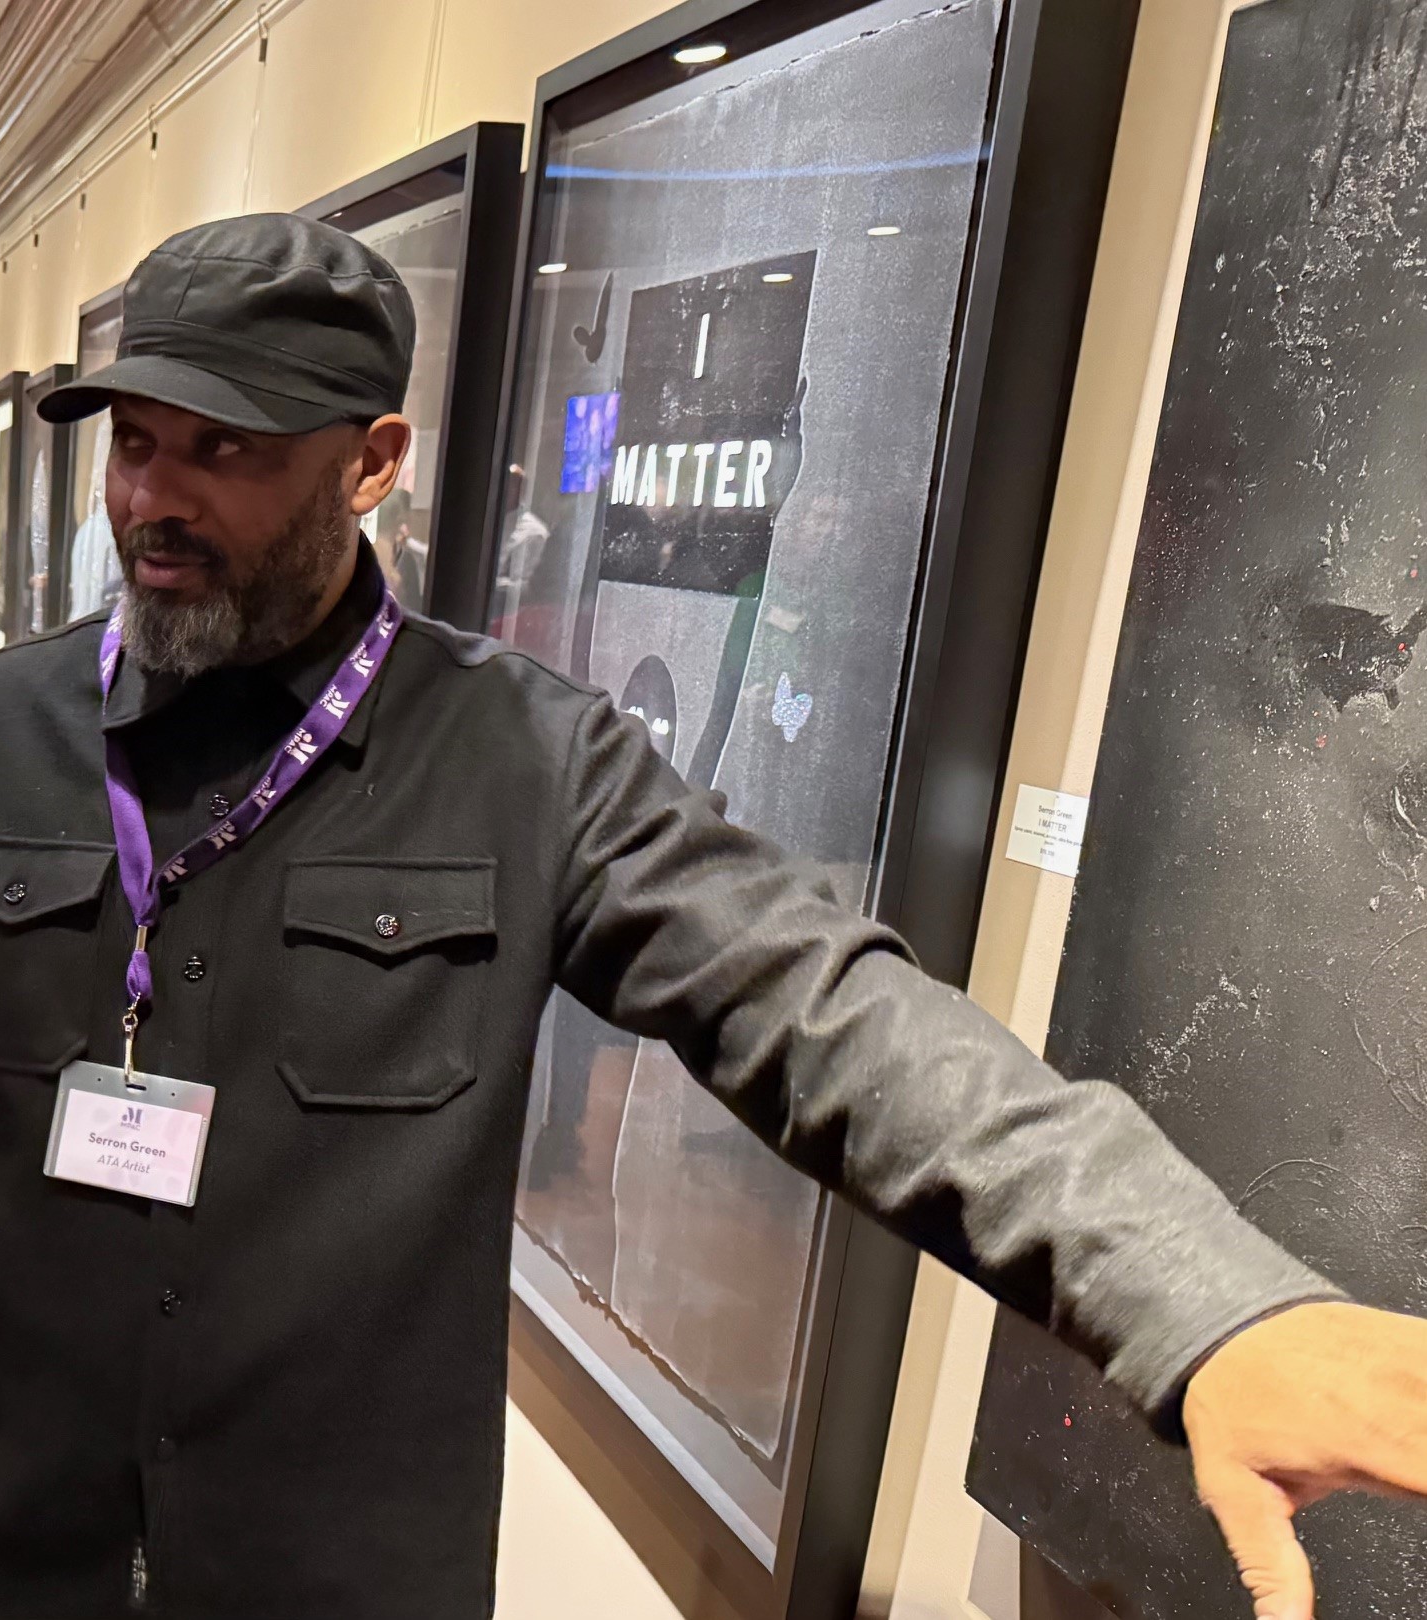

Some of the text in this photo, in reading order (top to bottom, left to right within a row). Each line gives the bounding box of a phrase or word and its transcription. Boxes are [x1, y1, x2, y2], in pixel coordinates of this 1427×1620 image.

[694, 312, 710, 379] I
[611, 439, 773, 508] MATTER
[1042, 819, 1067, 832] MATTER
[88, 1132, 166, 1158] Serron Green
[97, 1154, 151, 1174] ATA Artist
